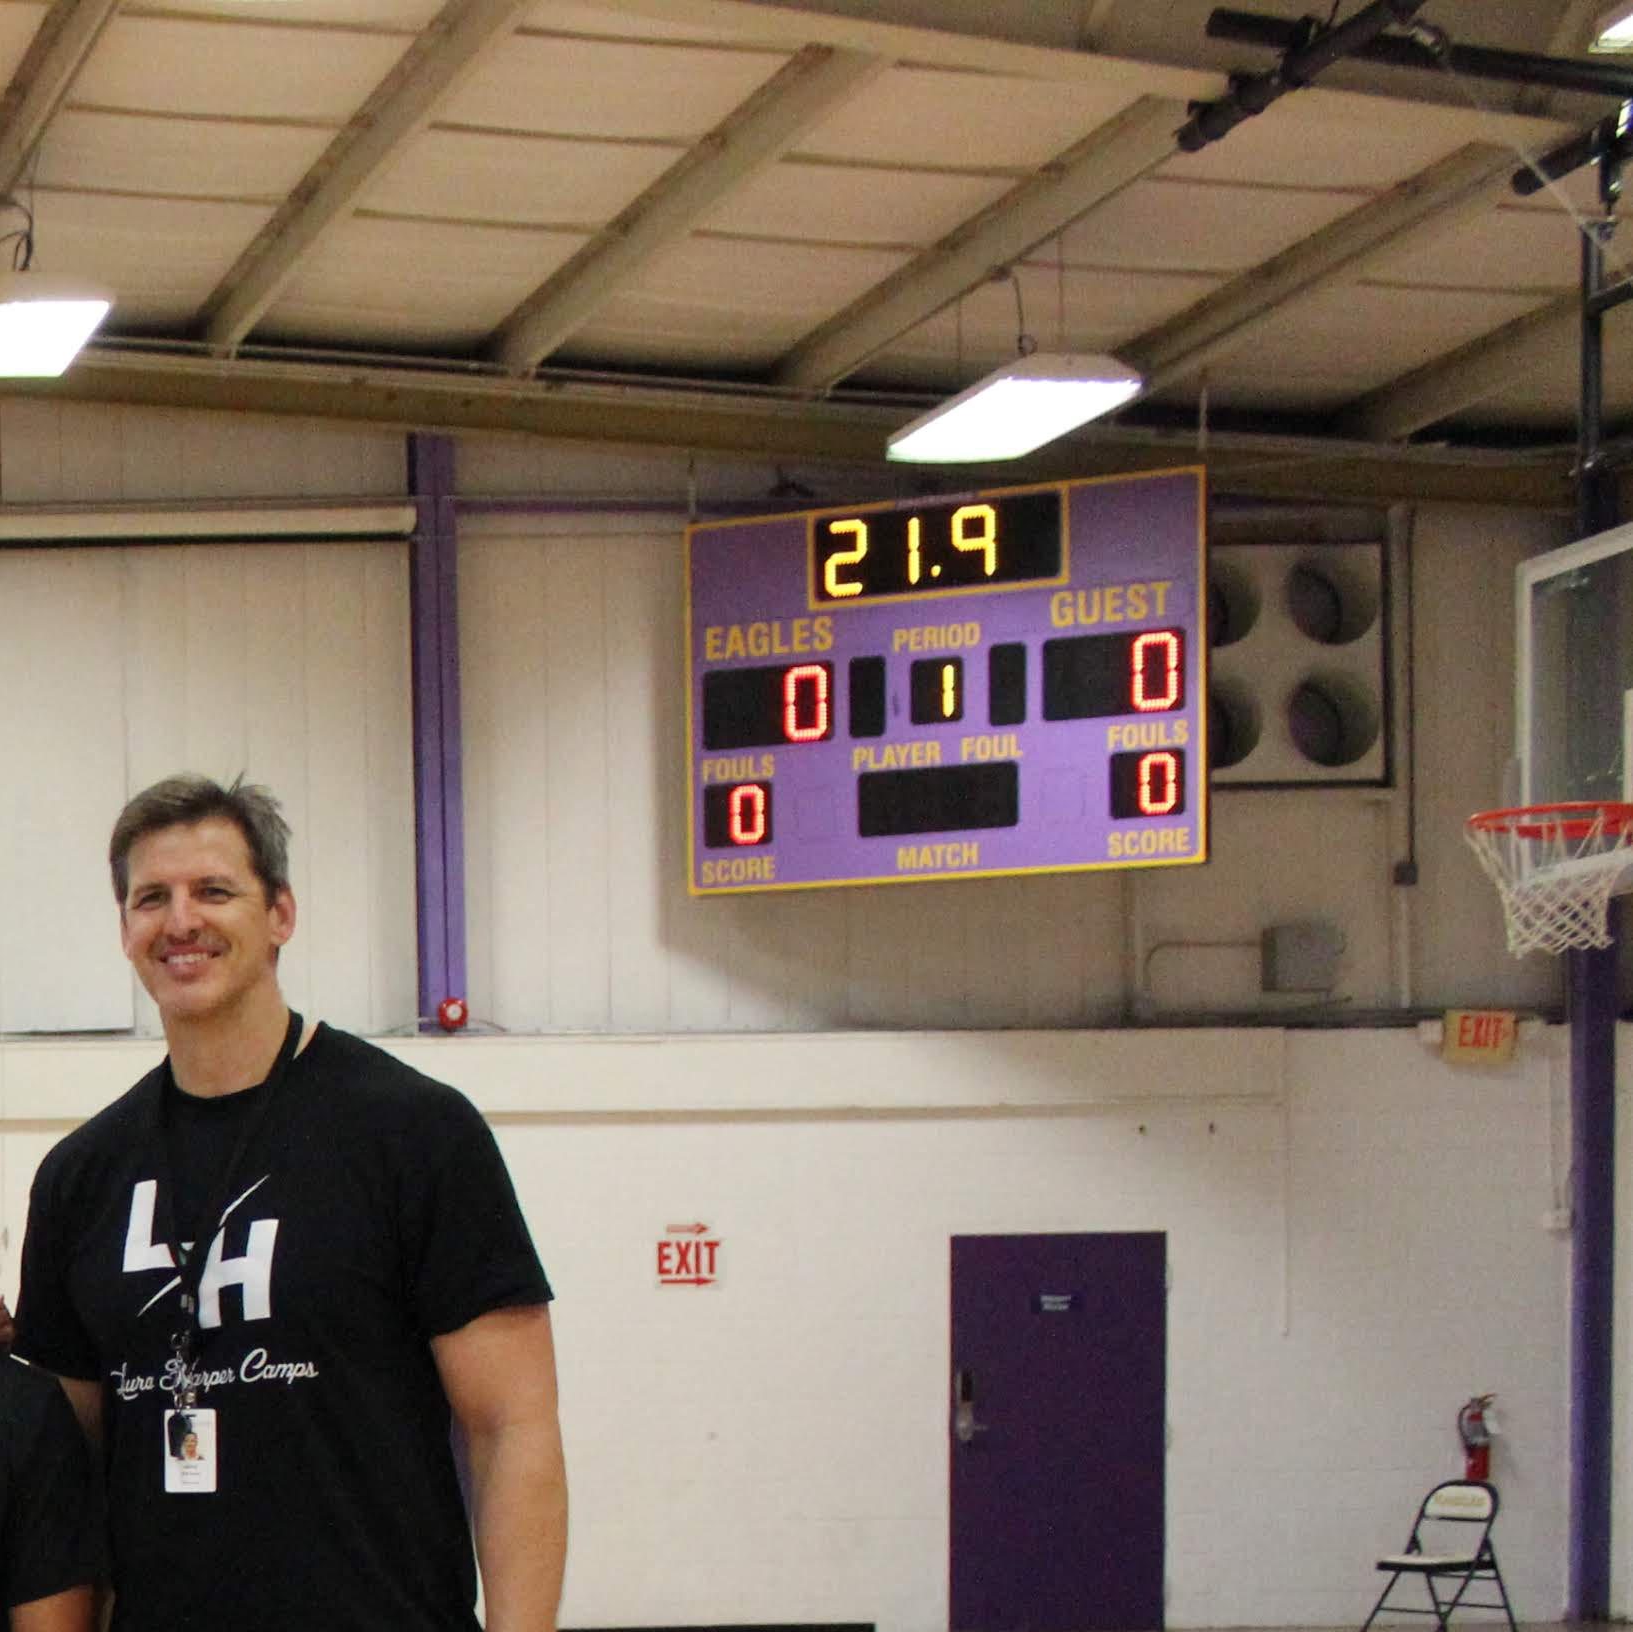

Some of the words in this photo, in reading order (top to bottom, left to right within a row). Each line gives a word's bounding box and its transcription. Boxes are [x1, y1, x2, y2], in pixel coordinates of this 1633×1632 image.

[823, 503, 998, 598] 21.9
[1050, 581, 1173, 627] GUEST
[705, 616, 834, 661] EAGLES
[893, 621, 981, 652] PERIOD
[1132, 630, 1179, 711] 0
[784, 664, 829, 742] 0
[851, 741, 942, 770] PLAYER
[960, 733, 1023, 761] FOUL
[1107, 719, 1189, 750] FOULS
[701, 753, 776, 783] FOULS
[1138, 751, 1177, 815] 0
[730, 783, 766, 845] 0
[896, 842, 980, 870] MATCH
[1107, 827, 1191, 857] SCORE
[701, 856, 776, 884] SCORE
[1458, 1014, 1504, 1049] EXIT
[656, 1240, 720, 1275] EXIT
[240, 1348, 320, 1384] Camps
